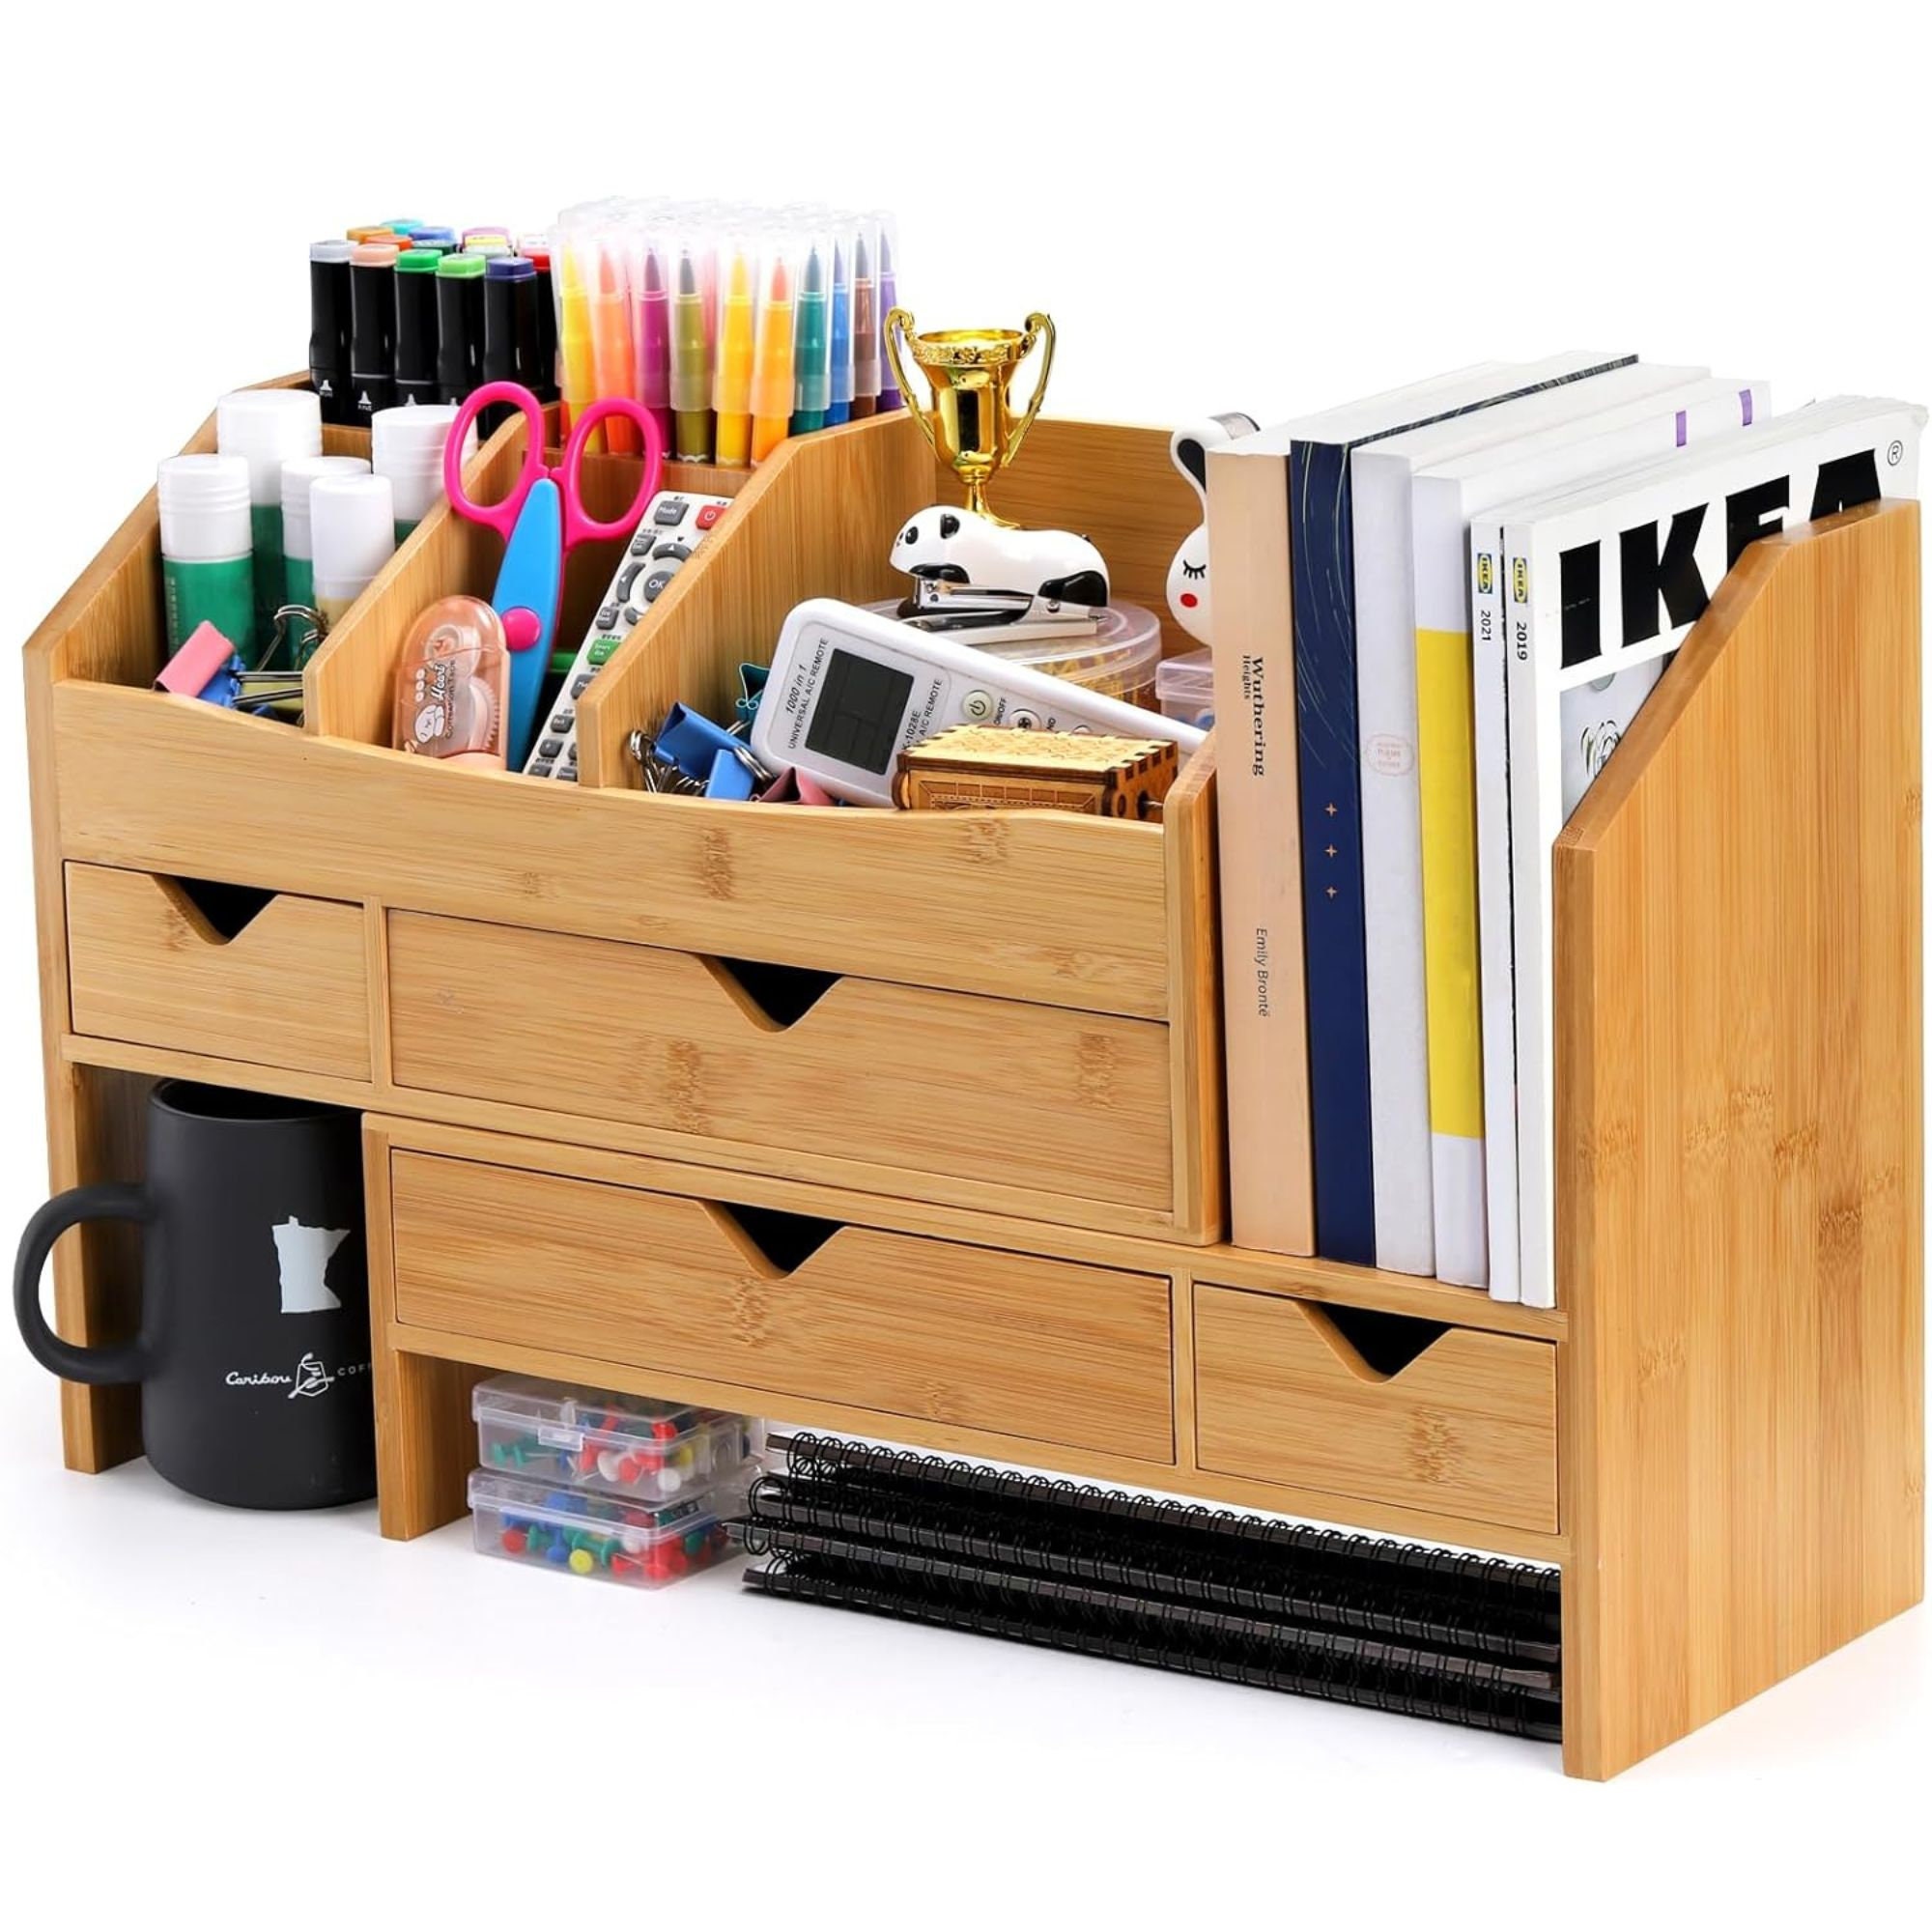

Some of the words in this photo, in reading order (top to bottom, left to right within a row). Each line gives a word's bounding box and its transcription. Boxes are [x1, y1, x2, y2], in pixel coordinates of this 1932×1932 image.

[1480, 611, 1492, 641] 2021
[1516, 621, 1528, 661] 2019
[810, 639, 829, 679] REMOTE
[785, 687, 801, 715] 1000
[796, 676, 806, 688] in
[807, 679, 816, 696] A/C
[923, 678, 943, 717] REMOTE
[788, 697, 810, 750] UNIVERSAL
[918, 719, 929, 736] A/C
[1252, 657, 1266, 777] Wuthering
[1254, 927, 1267, 967] Emily
[225, 1371, 292, 1385] Caribou
[337, 1362, 372, 1377] COF
